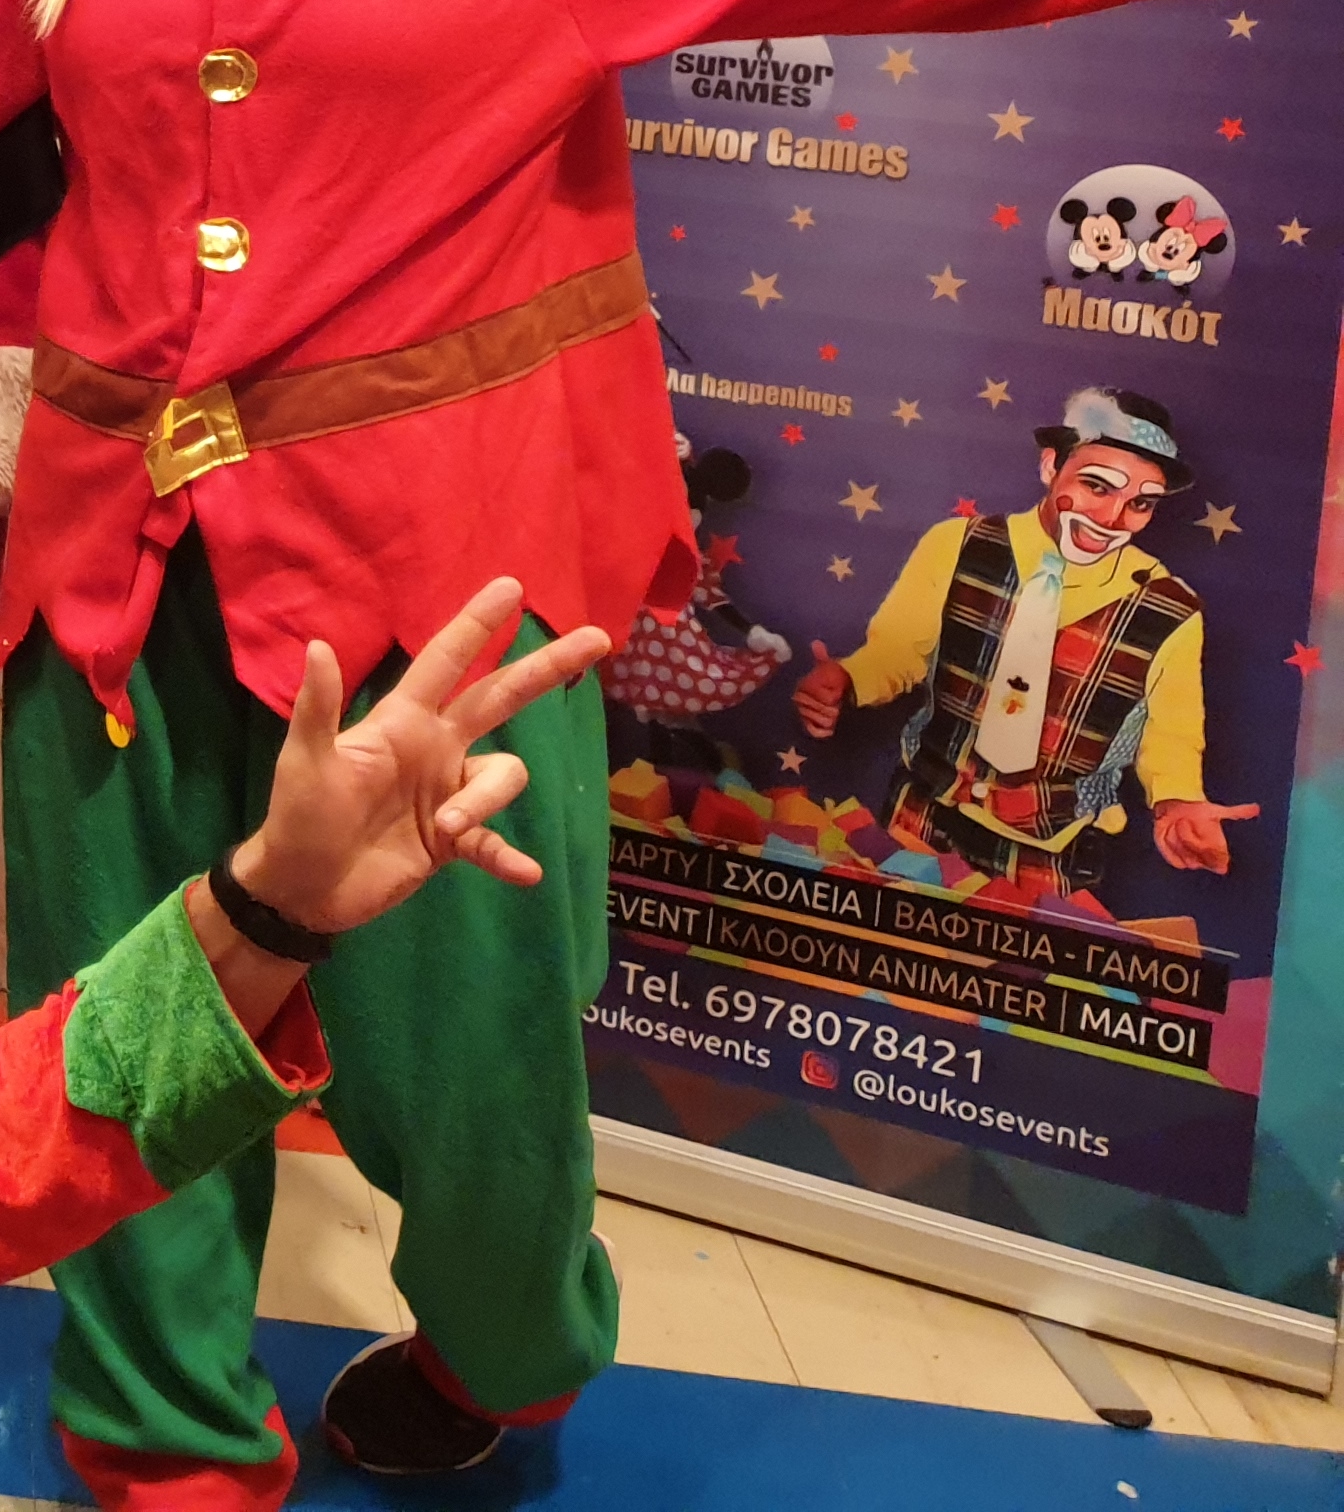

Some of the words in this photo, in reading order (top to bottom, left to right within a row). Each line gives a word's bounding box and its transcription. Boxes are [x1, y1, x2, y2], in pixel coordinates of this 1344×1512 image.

[691, 77, 812, 108] GAMES
[626, 118, 759, 164] urvivor
[766, 127, 909, 180] Games
[1042, 287, 1223, 347] Μασκότ
[700, 372, 854, 418] happenings
[722, 861, 862, 920] ΣΧΟΛΕΙΑ
[893, 900, 1055, 964] ΒΑΦΤΙΣΙΑ
[1084, 944, 1201, 997] ΓΑΜΟΙ
[618, 961, 691, 1009] Tel.
[705, 985, 983, 1084] 6978078421
[720, 916, 860, 976] ΚΛΟΟΥΝ
[868, 953, 1048, 1021] ANIMATER
[1079, 1002, 1197, 1058] ΜΑΓΟΙ
[582, 1004, 771, 1068] oukosevents
[853, 1069, 1111, 1157] @loukosevents
